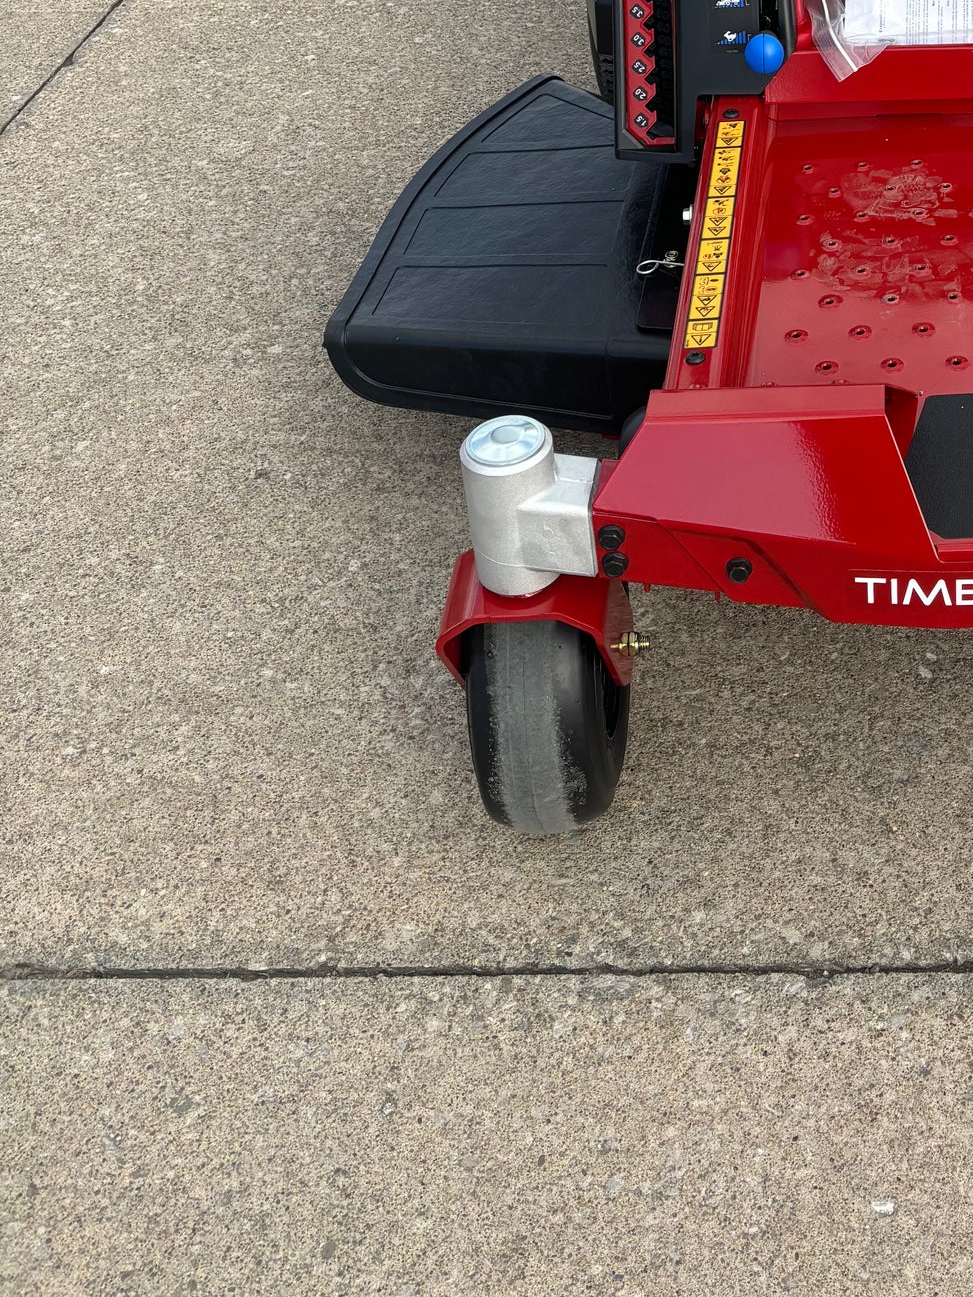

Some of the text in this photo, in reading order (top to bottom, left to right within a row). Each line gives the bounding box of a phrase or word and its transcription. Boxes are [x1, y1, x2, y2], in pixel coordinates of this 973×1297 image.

[631, 7, 643, 18] 3.5
[633, 34, 645, 45] 3.0
[633, 61, 645, 73] 2.5
[635, 88, 647, 99] 2.0
[635, 115, 647, 126] 1.5
